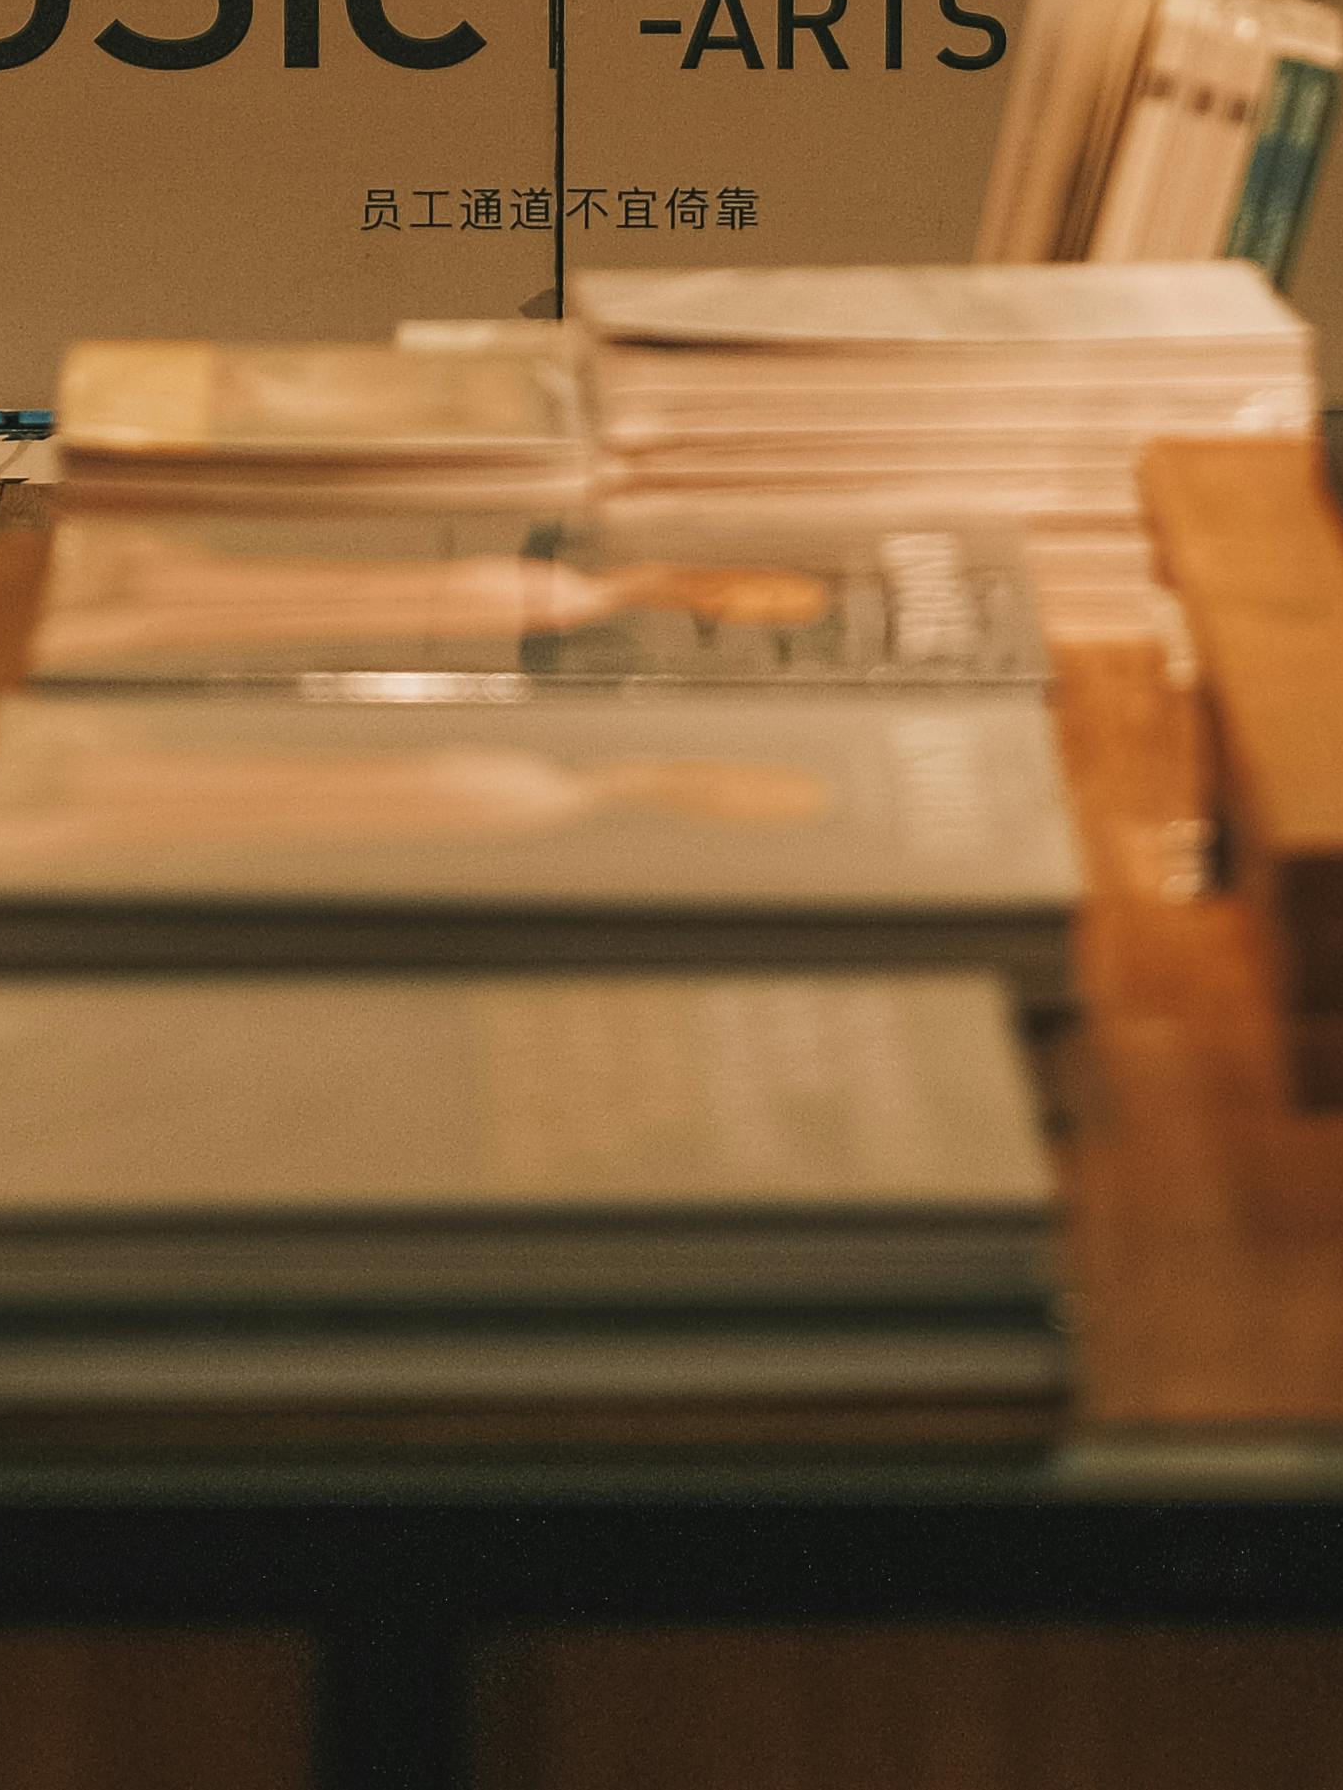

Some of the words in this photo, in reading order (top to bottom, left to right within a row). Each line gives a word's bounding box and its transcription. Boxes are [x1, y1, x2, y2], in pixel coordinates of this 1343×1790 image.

[360, 186, 760, 233] 员工通道不宜倚靠
